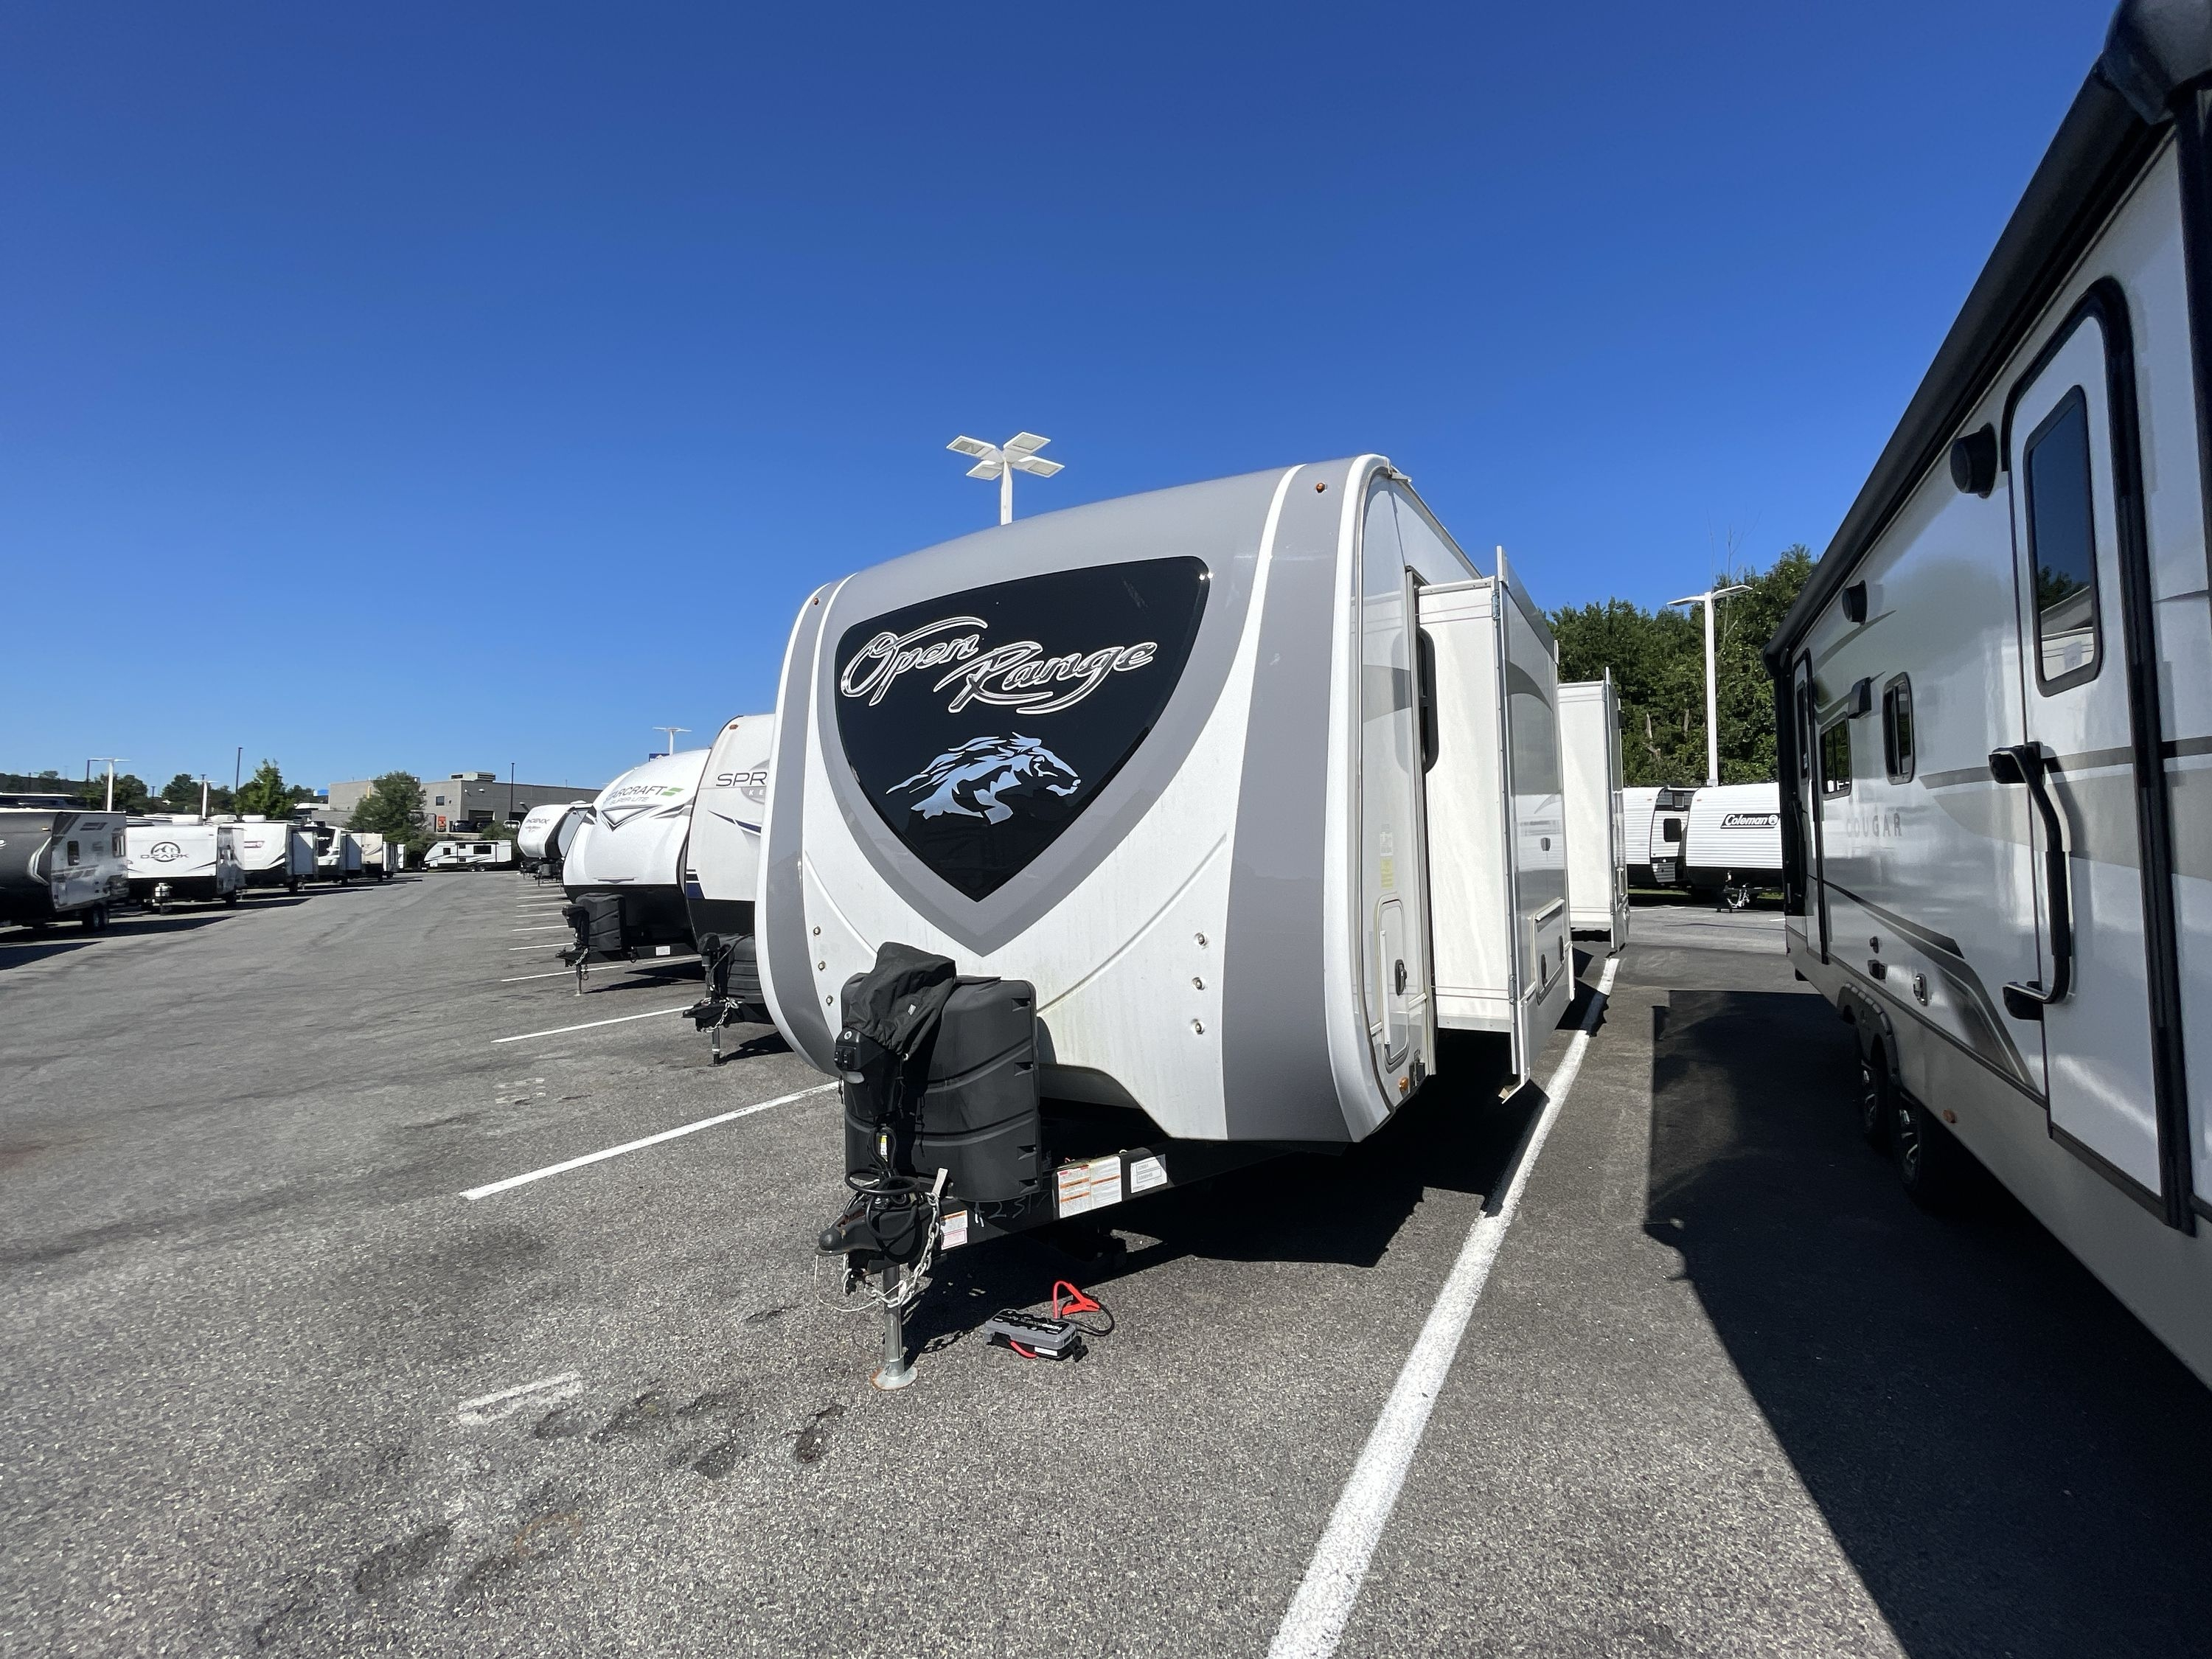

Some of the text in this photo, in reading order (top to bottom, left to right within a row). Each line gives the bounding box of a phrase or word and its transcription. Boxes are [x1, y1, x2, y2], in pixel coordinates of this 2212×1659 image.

[841, 616, 1158, 714] Open Range
[1725, 814, 1768, 826] Coleman
[1846, 813, 1902, 838] COUGAR
